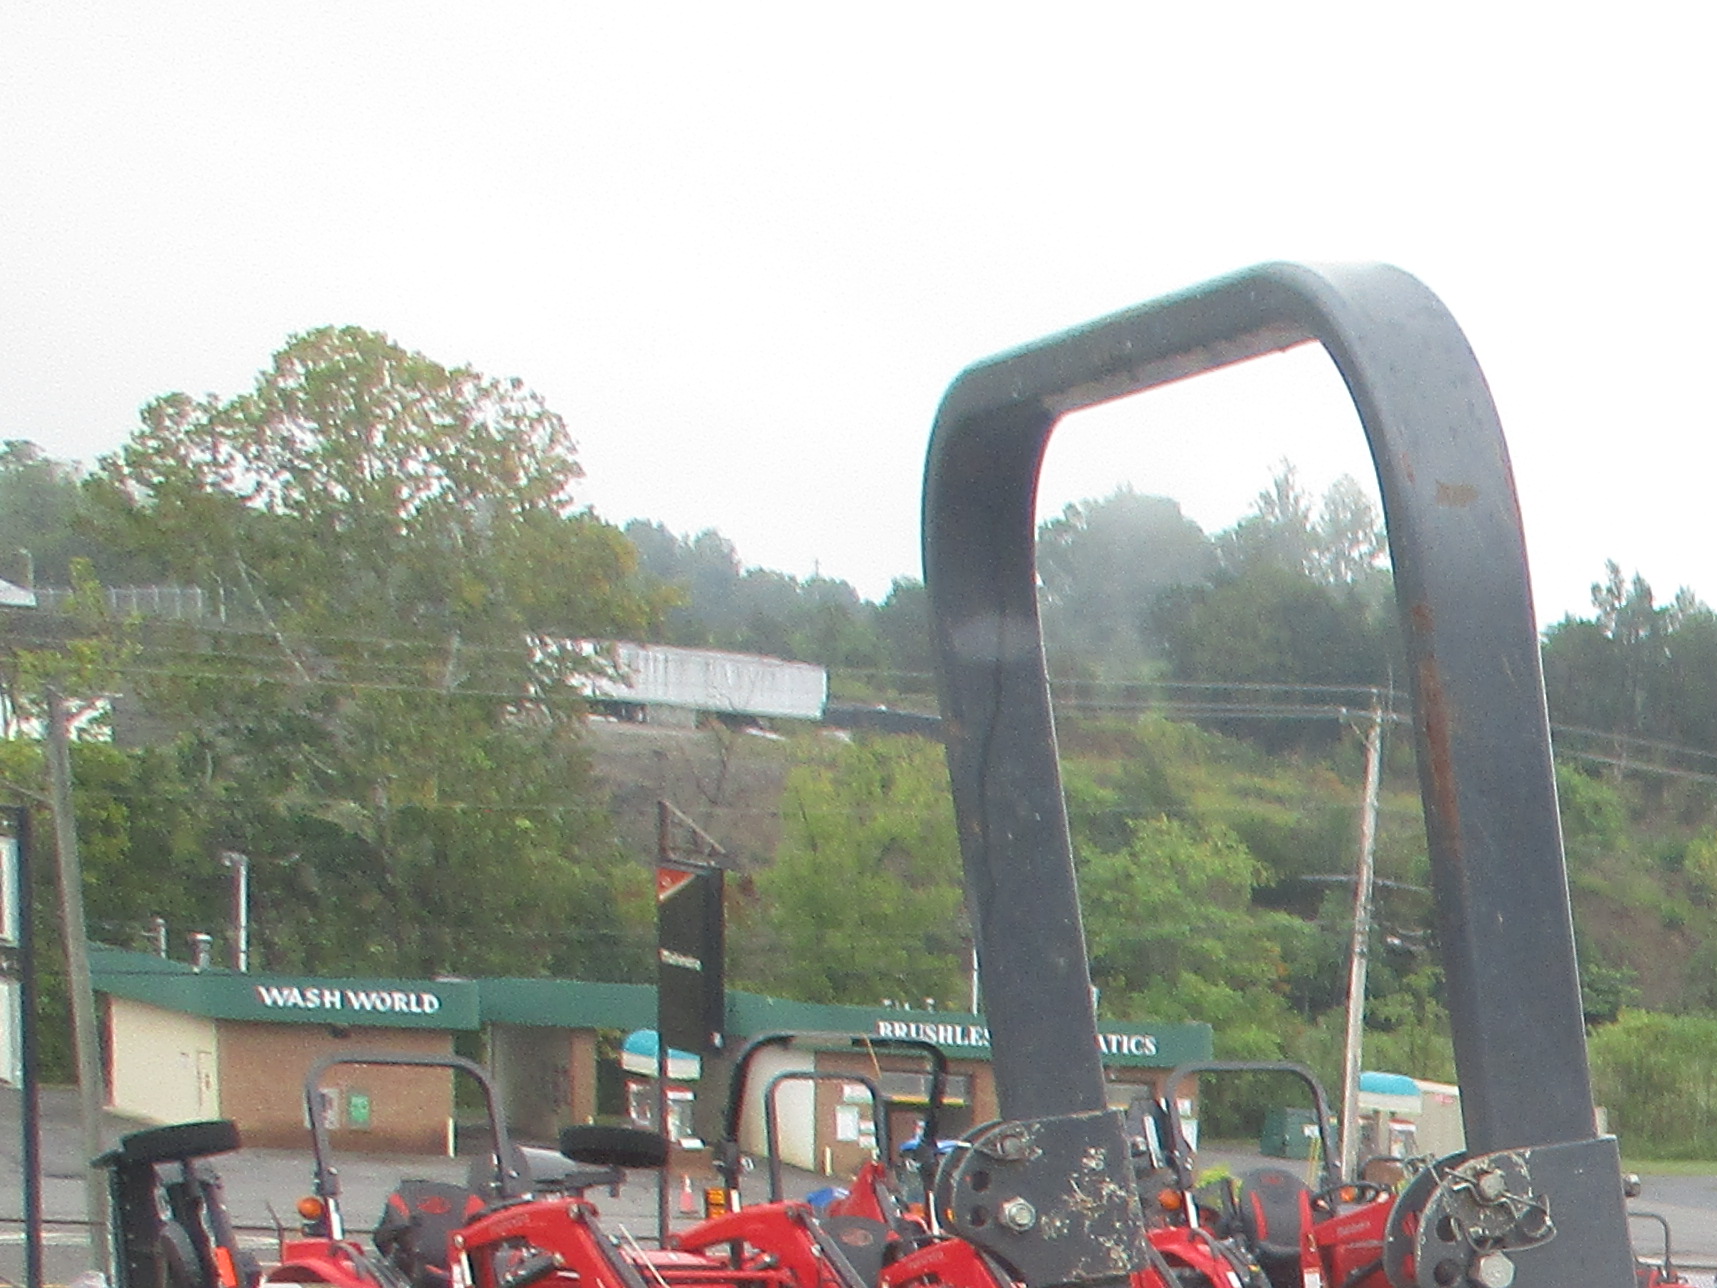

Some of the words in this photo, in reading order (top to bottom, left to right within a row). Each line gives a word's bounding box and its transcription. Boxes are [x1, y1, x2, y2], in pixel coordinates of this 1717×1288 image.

[256, 985, 343, 1010] WASH
[344, 989, 442, 1014] WORLD
[876, 1021, 992, 1048] BRUSHLES
